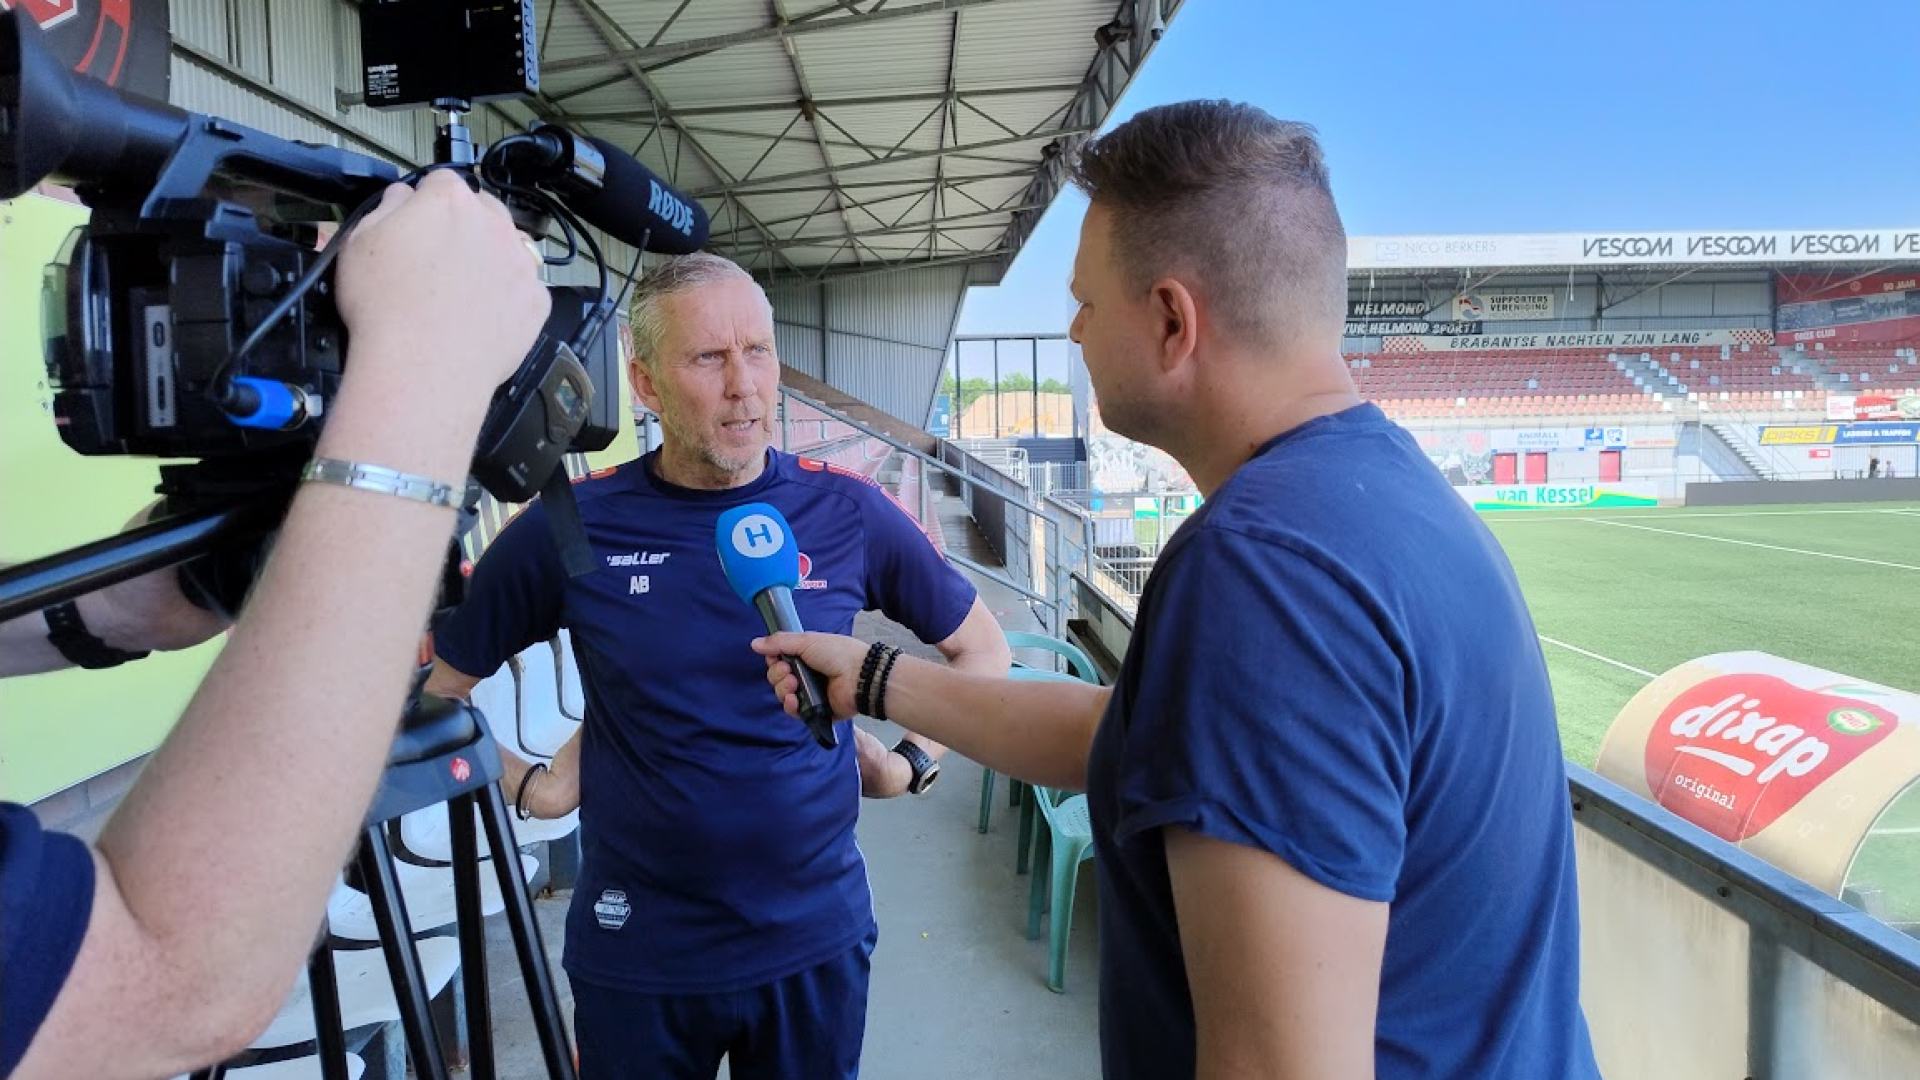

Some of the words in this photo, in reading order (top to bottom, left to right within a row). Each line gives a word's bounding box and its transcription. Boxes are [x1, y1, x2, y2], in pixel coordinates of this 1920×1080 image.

[648, 179, 695, 236] RØDE
[1405, 243, 1440, 253] NICO
[1445, 241, 1497, 252] BERKERS
[1583, 237, 1673, 257] VESCOM
[1687, 236, 1776, 256] VESCOM
[1791, 235, 1879, 254] VESCOM
[1354, 303, 1424, 315] HELMOND
[1490, 296, 1548, 304] SUPPORTERS
[1369, 322, 1429, 334] HELMOND
[1450, 336, 1537, 348] BRABANTSE
[1546, 335, 1614, 346] NACHTEN
[1621, 334, 1655, 345] ZIJN
[1765, 430, 1816, 440] DIRKS
[1496, 489, 1527, 503] van
[1537, 485, 1595, 503] Kessel
[745, 524, 772, 547] H
[629, 575, 650, 595] AB
[1670, 693, 1830, 784] dixap
[1674, 774, 1737, 810] original
